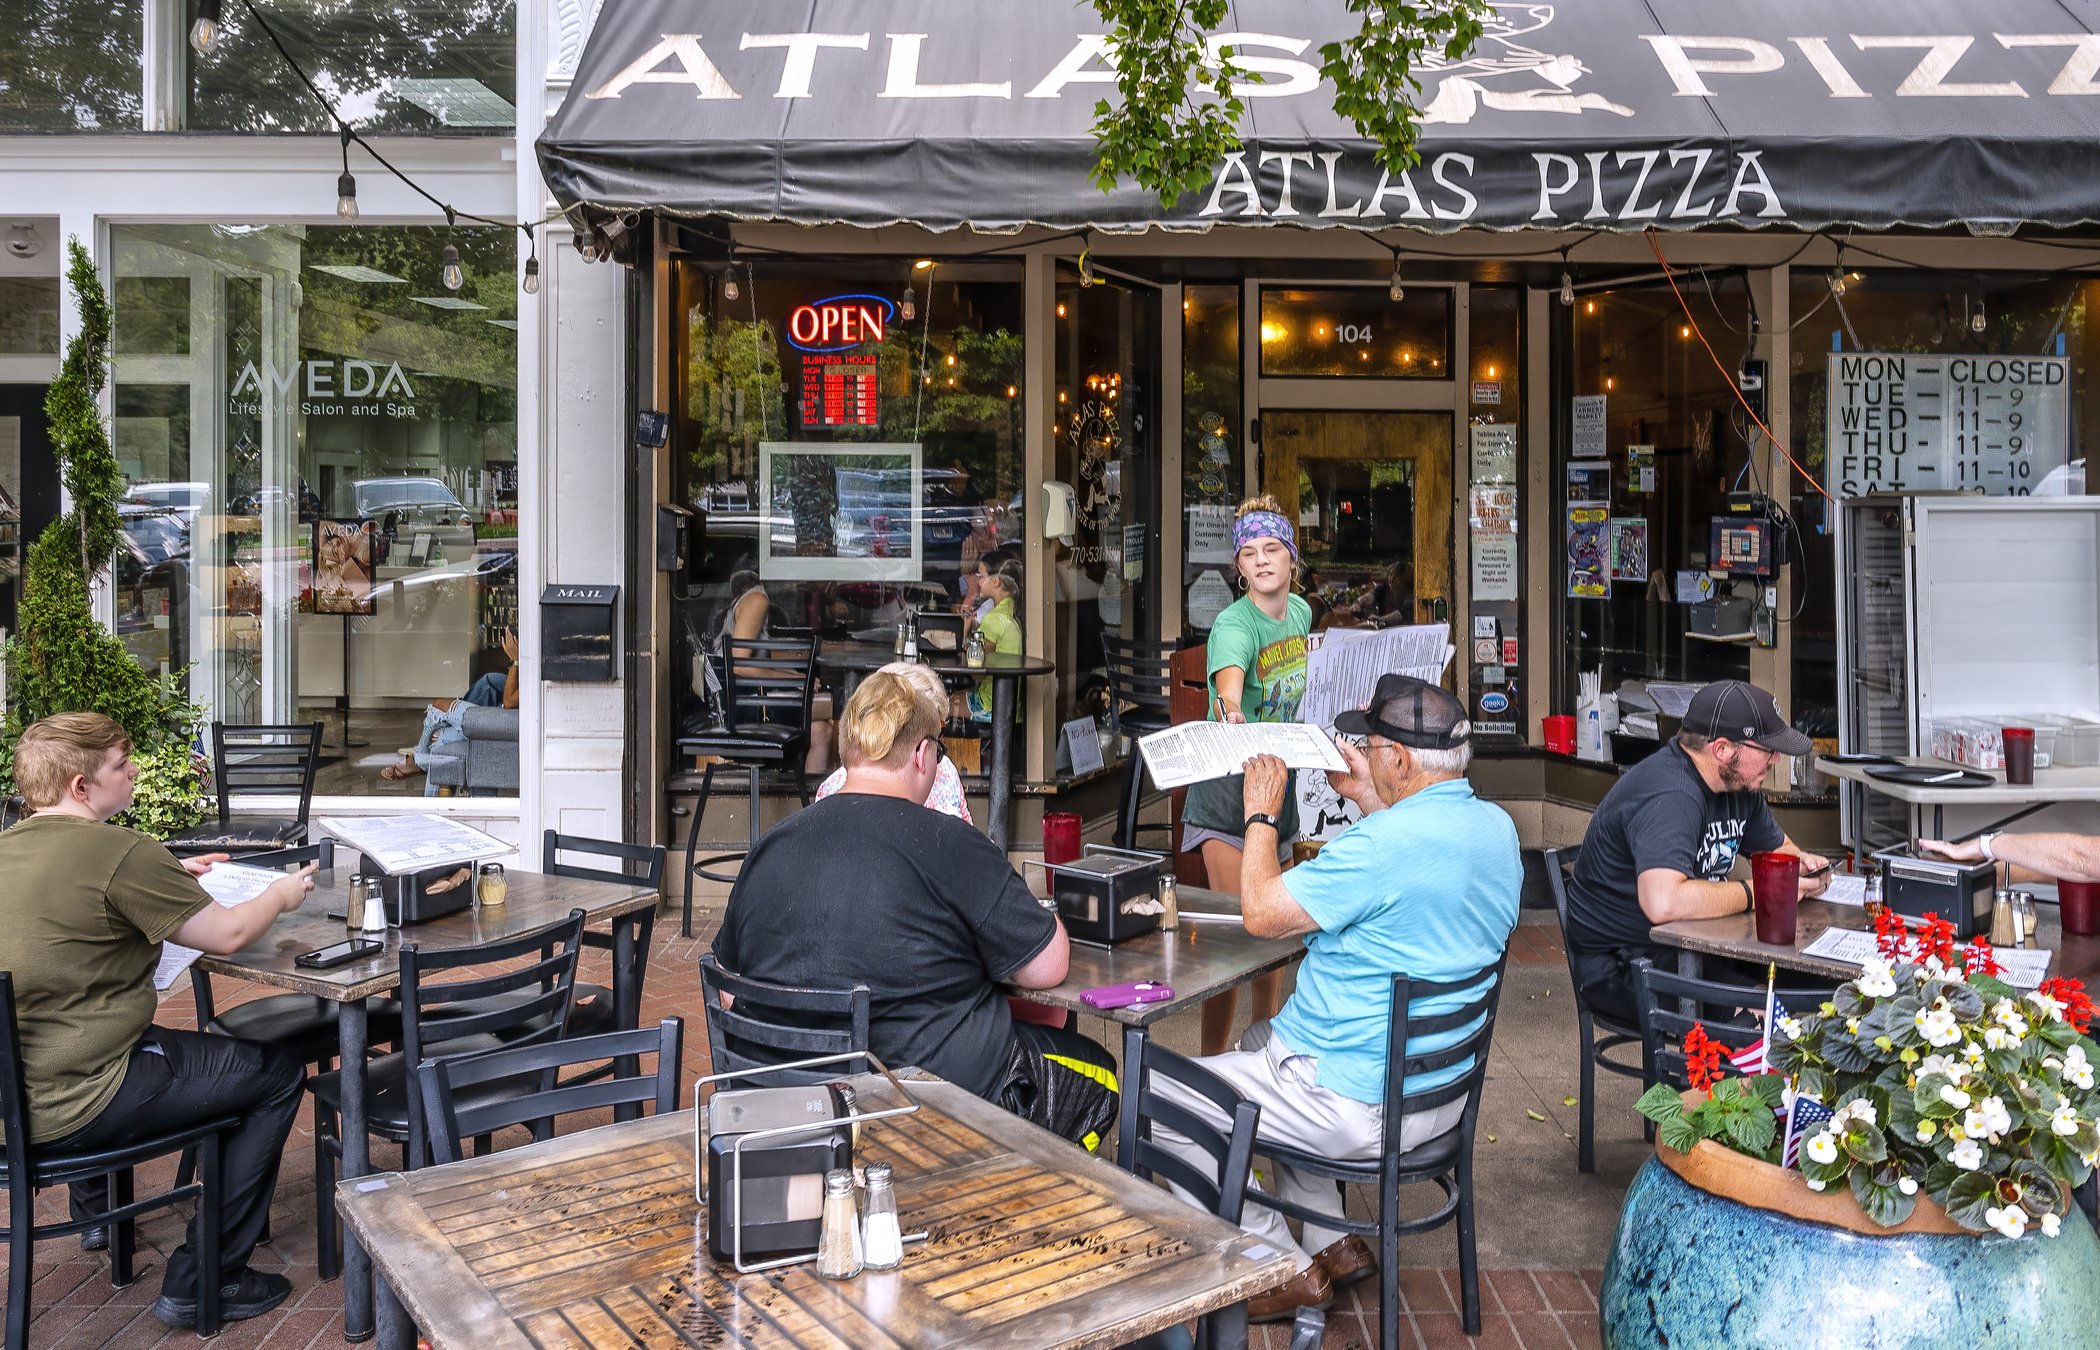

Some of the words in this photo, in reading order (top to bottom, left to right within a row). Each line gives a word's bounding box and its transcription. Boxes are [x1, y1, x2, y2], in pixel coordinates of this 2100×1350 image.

[1199, 150, 1479, 220] ATLAS
[1531, 148, 1787, 219] PIZZA
[791, 305, 884, 342] OPEN
[1335, 324, 1373, 343] 104
[803, 355, 842, 365] BUSINESS
[845, 355, 877, 365] HOURS
[230, 359, 416, 398] AVEDA
[1841, 357, 1905, 381] MON
[1950, 359, 2065, 385] CLOSED
[1843, 382, 1905, 406] TUE
[229, 402, 295, 417] Lifesye
[301, 402, 344, 415] Salon
[351, 403, 379, 415] and
[386, 402, 416, 418] Spa
[1841, 406, 1907, 430] WED
[1842, 432, 1907, 455] THU
[1477, 459, 1492, 467] Only
[1842, 456, 1900, 480] FRI
[321, 523, 363, 537] AVEDA
[1194, 540, 1209, 548] Only
[1481, 555, 1508, 563] Accepting
[557, 588, 603, 598] MAIL
[1473, 722, 1483, 732] No
[1484, 722, 1515, 733] Soliciting
